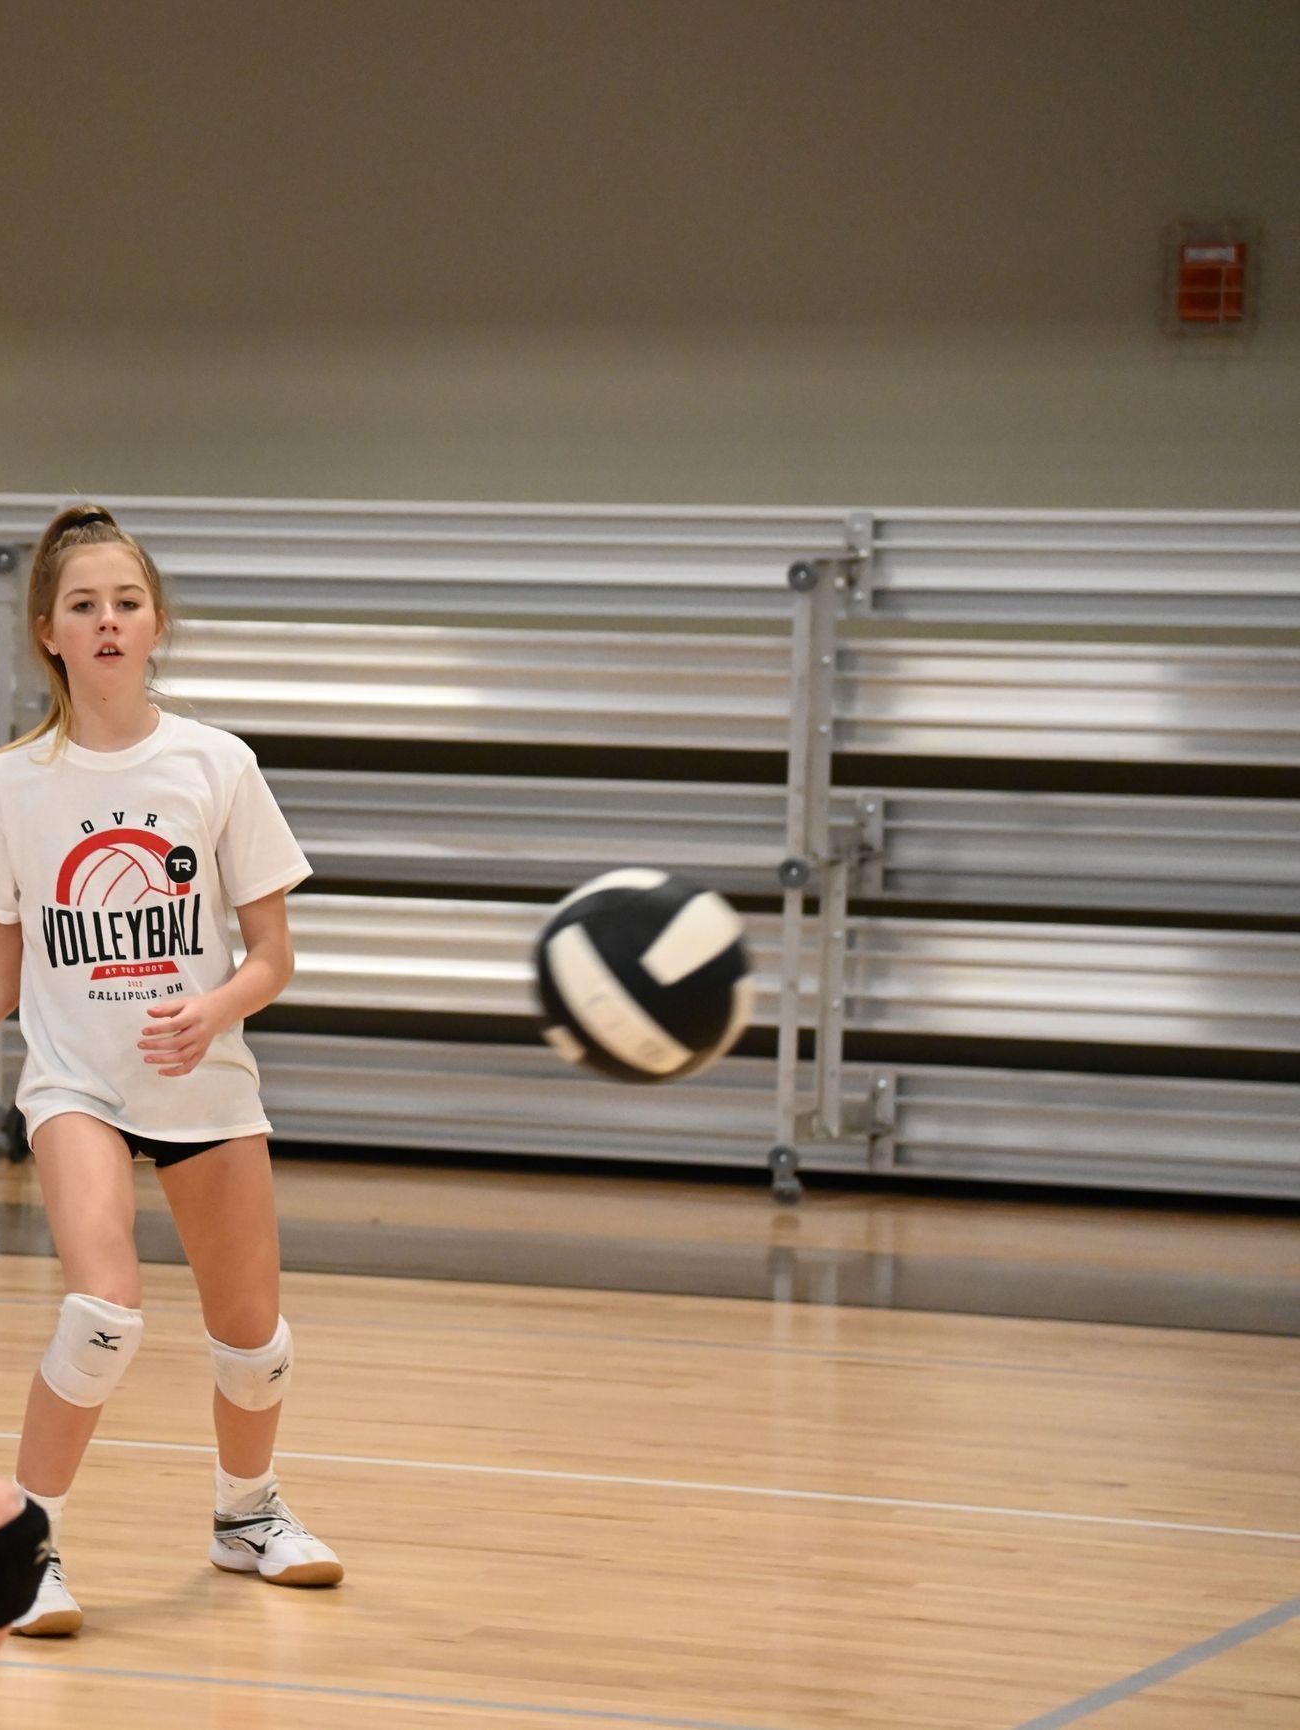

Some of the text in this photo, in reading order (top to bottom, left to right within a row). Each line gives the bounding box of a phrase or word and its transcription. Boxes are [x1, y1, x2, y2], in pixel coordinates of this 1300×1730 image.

[171, 858, 192, 872] TR
[41, 893, 204, 968] VOLLEYBALL
[105, 967, 117, 975] AT
[166, 982, 184, 995] OH
